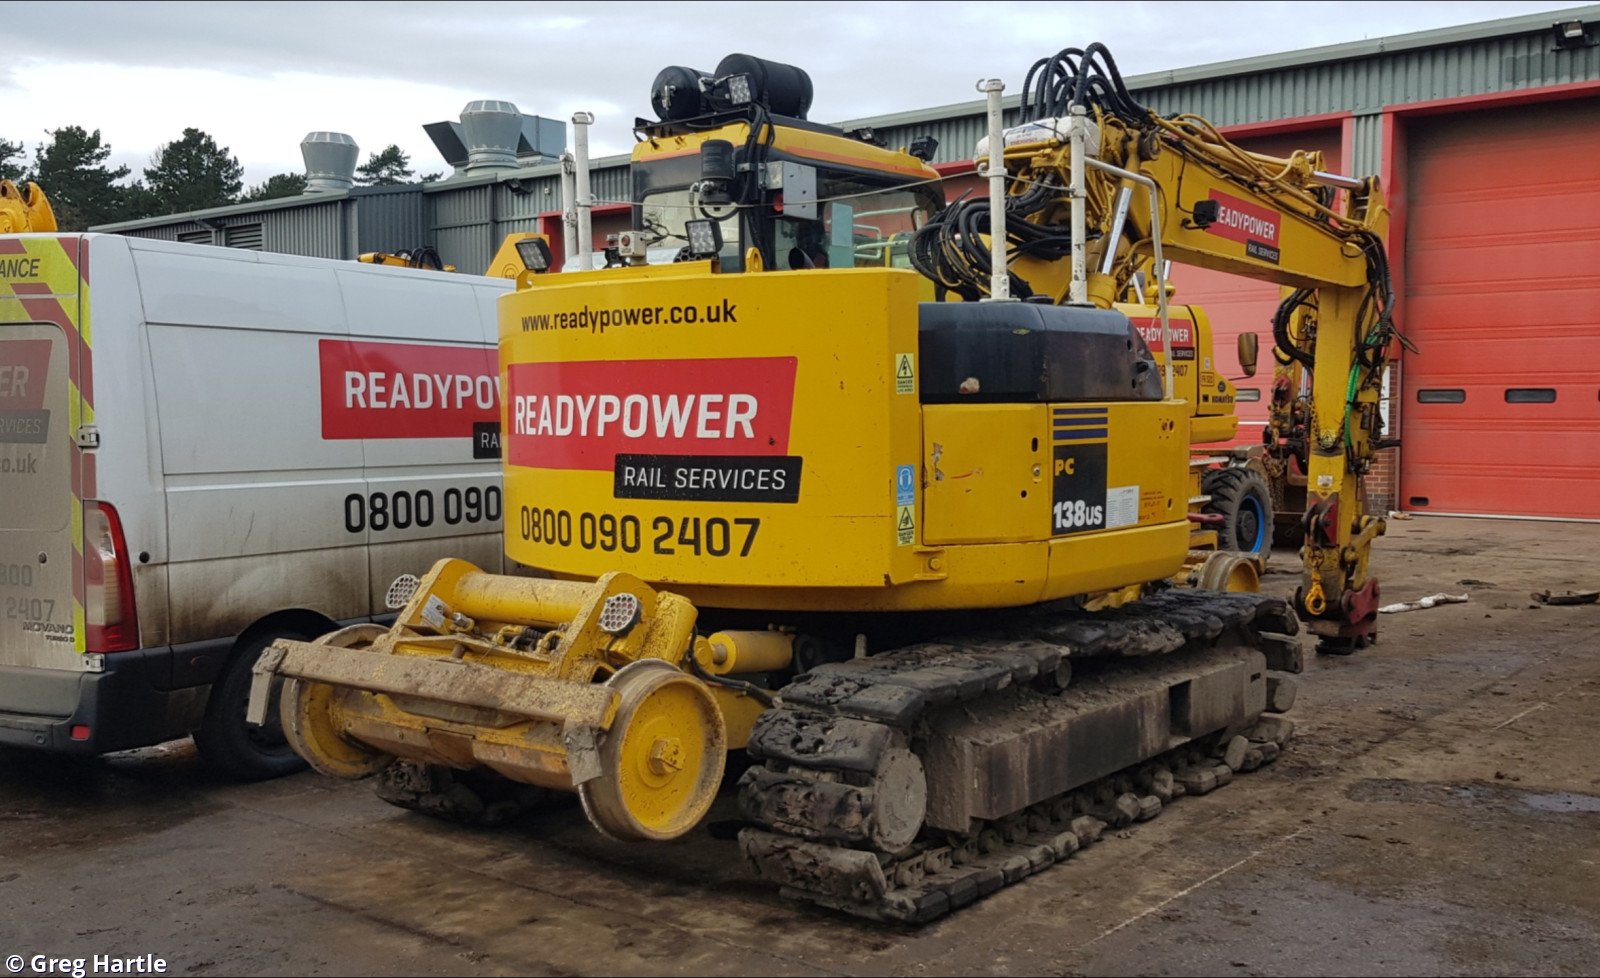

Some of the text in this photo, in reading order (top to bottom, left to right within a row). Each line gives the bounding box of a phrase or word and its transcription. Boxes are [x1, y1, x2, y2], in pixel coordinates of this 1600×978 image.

[1217, 206, 1275, 240] EADYPOWER
[1258, 246, 1278, 260] SERVICES
[521, 298, 738, 335] www.readypower.co.uk
[515, 393, 758, 439] READYPOWER
[623, 466, 787, 490] RAIL SERVICES
[1055, 458, 1075, 476] PC
[344, 485, 502, 533] 0800 090
[521, 505, 761, 557] 0800 090 2407
[6, 597, 55, 621] 2407
[23, 621, 75, 634] MOVANO
